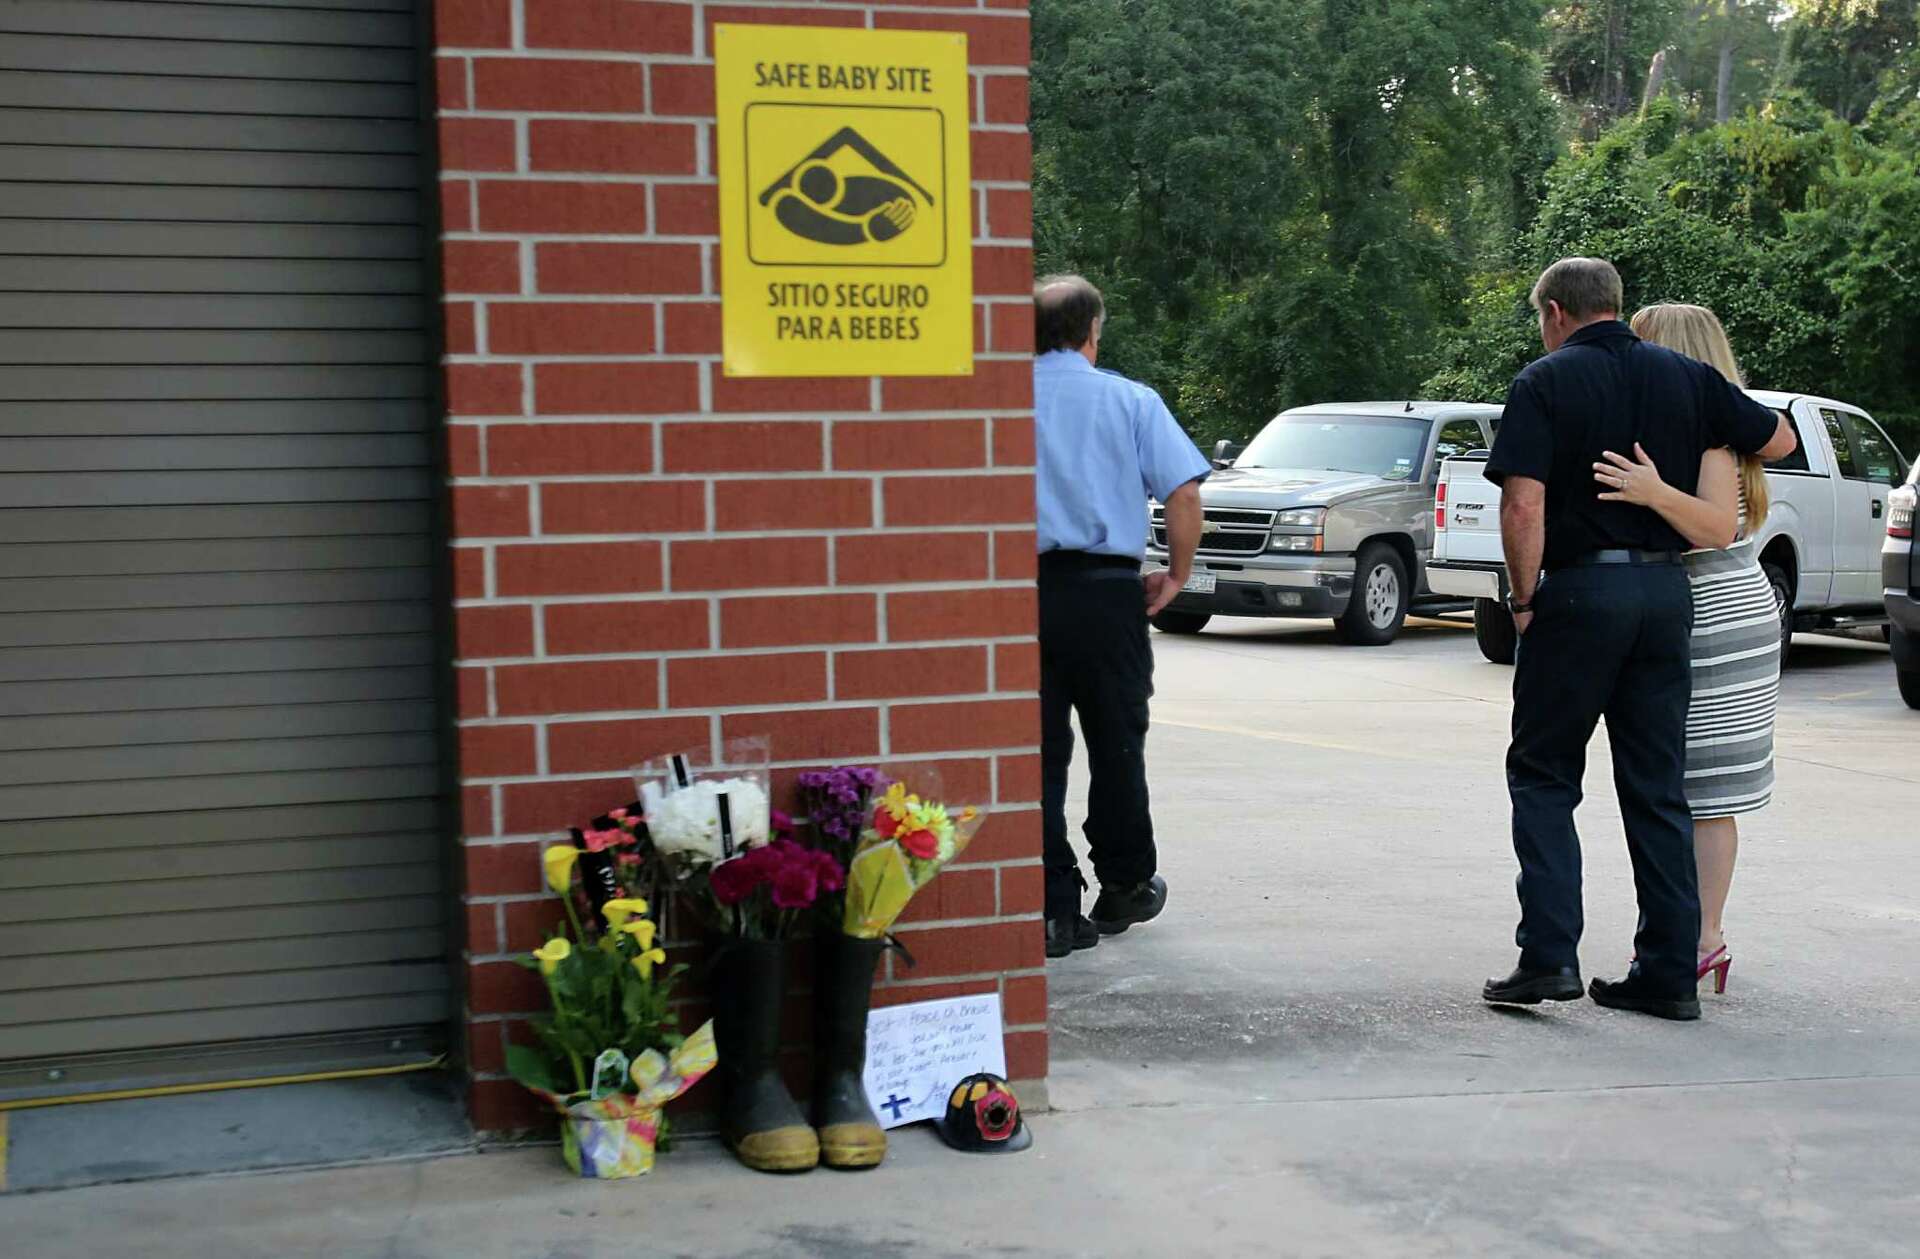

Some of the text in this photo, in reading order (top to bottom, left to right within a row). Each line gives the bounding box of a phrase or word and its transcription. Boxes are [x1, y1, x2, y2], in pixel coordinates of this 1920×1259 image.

[755, 62, 932, 93] SAFE BABY SITE
[768, 282, 929, 309] SITIO SEGURO
[778, 316, 843, 340] PARA
